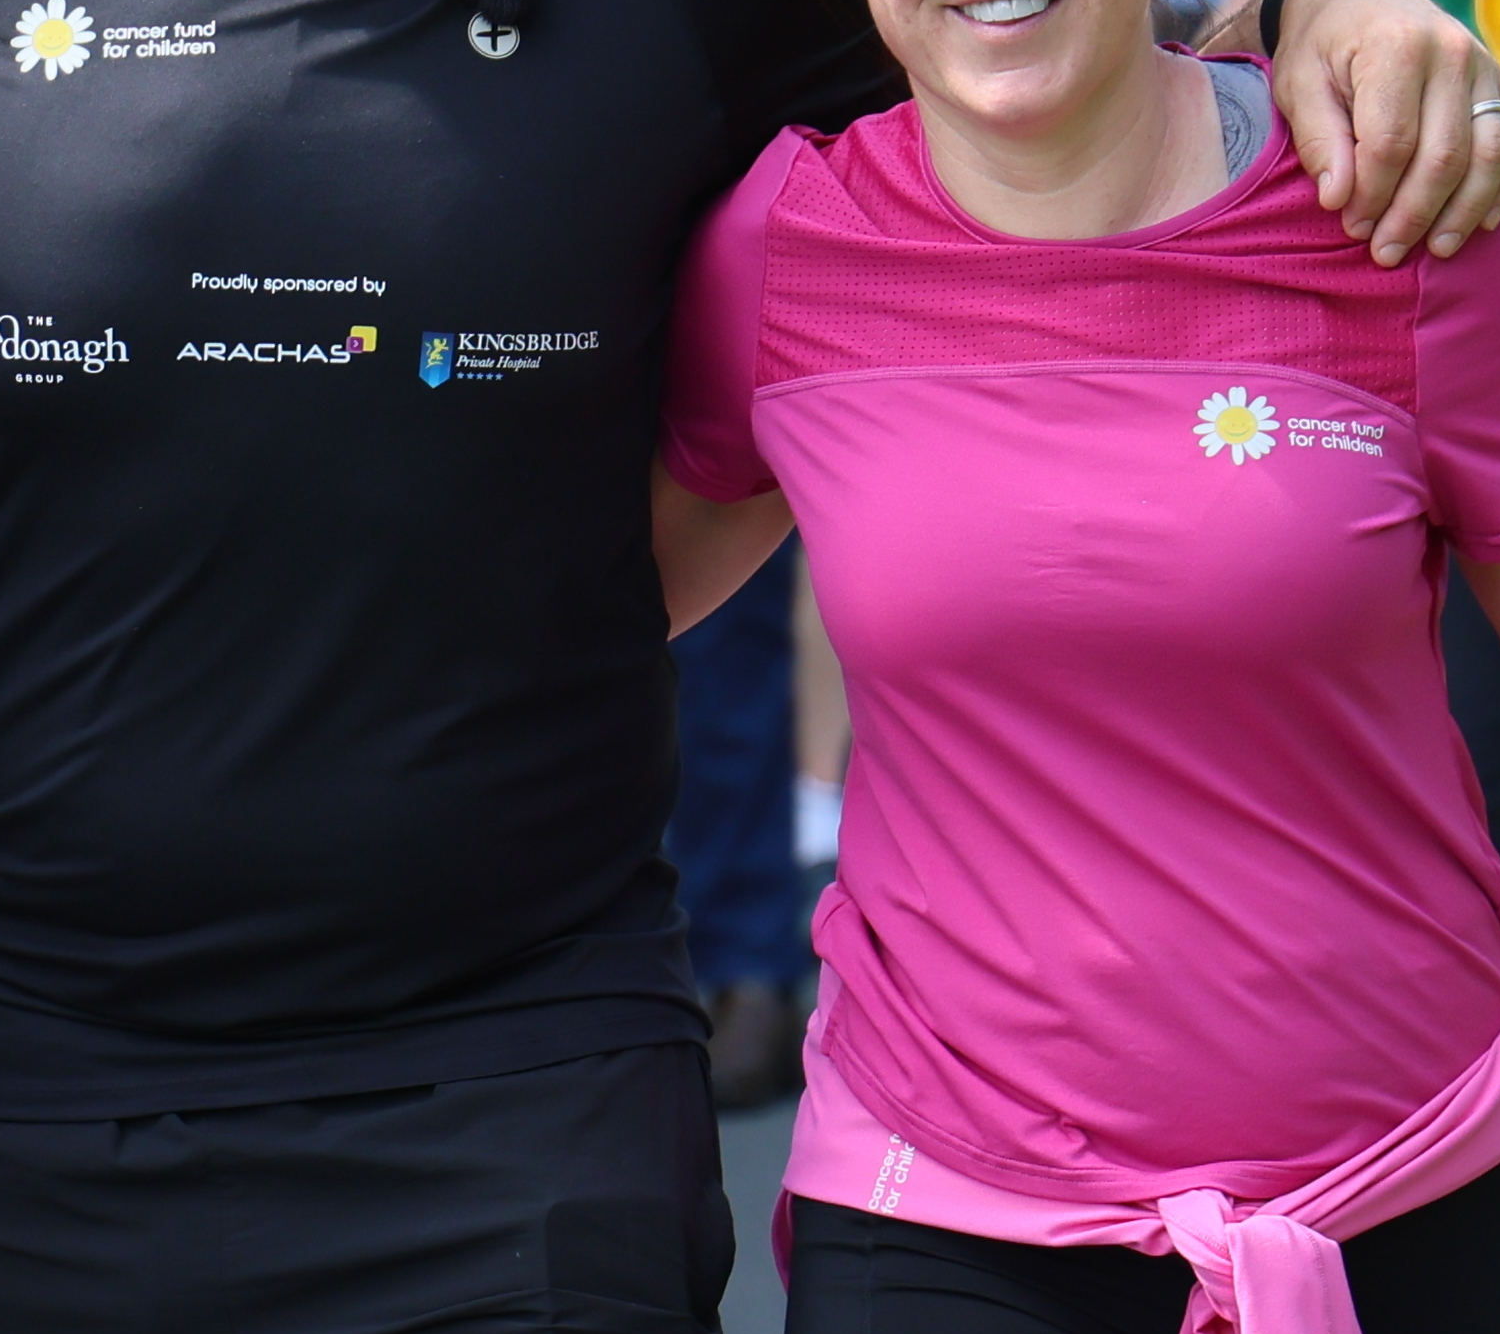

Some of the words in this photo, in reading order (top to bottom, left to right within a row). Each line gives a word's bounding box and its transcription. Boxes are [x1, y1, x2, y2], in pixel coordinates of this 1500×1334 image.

[103, 25, 169, 40] cancer
[174, 20, 217, 38] fund
[102, 42, 130, 58] for
[136, 39, 216, 58] children
[191, 272, 258, 293] Proudly
[263, 275, 357, 294] sponsored
[363, 276, 386, 297] by
[27, 315, 54, 327] THE
[176, 341, 351, 364] ARACHAS
[457, 331, 600, 352] KINGSBRIDGE
[455, 354, 495, 369] Private
[496, 355, 541, 371] Hospital
[15, 373, 64, 384] GROUP
[1287, 416, 1346, 433] cancer
[1352, 421, 1385, 440] fund
[1288, 431, 1316, 448] for
[1321, 433, 1383, 458] children
[867, 1148, 897, 1210] cancer
[880, 1187, 902, 1214] for
